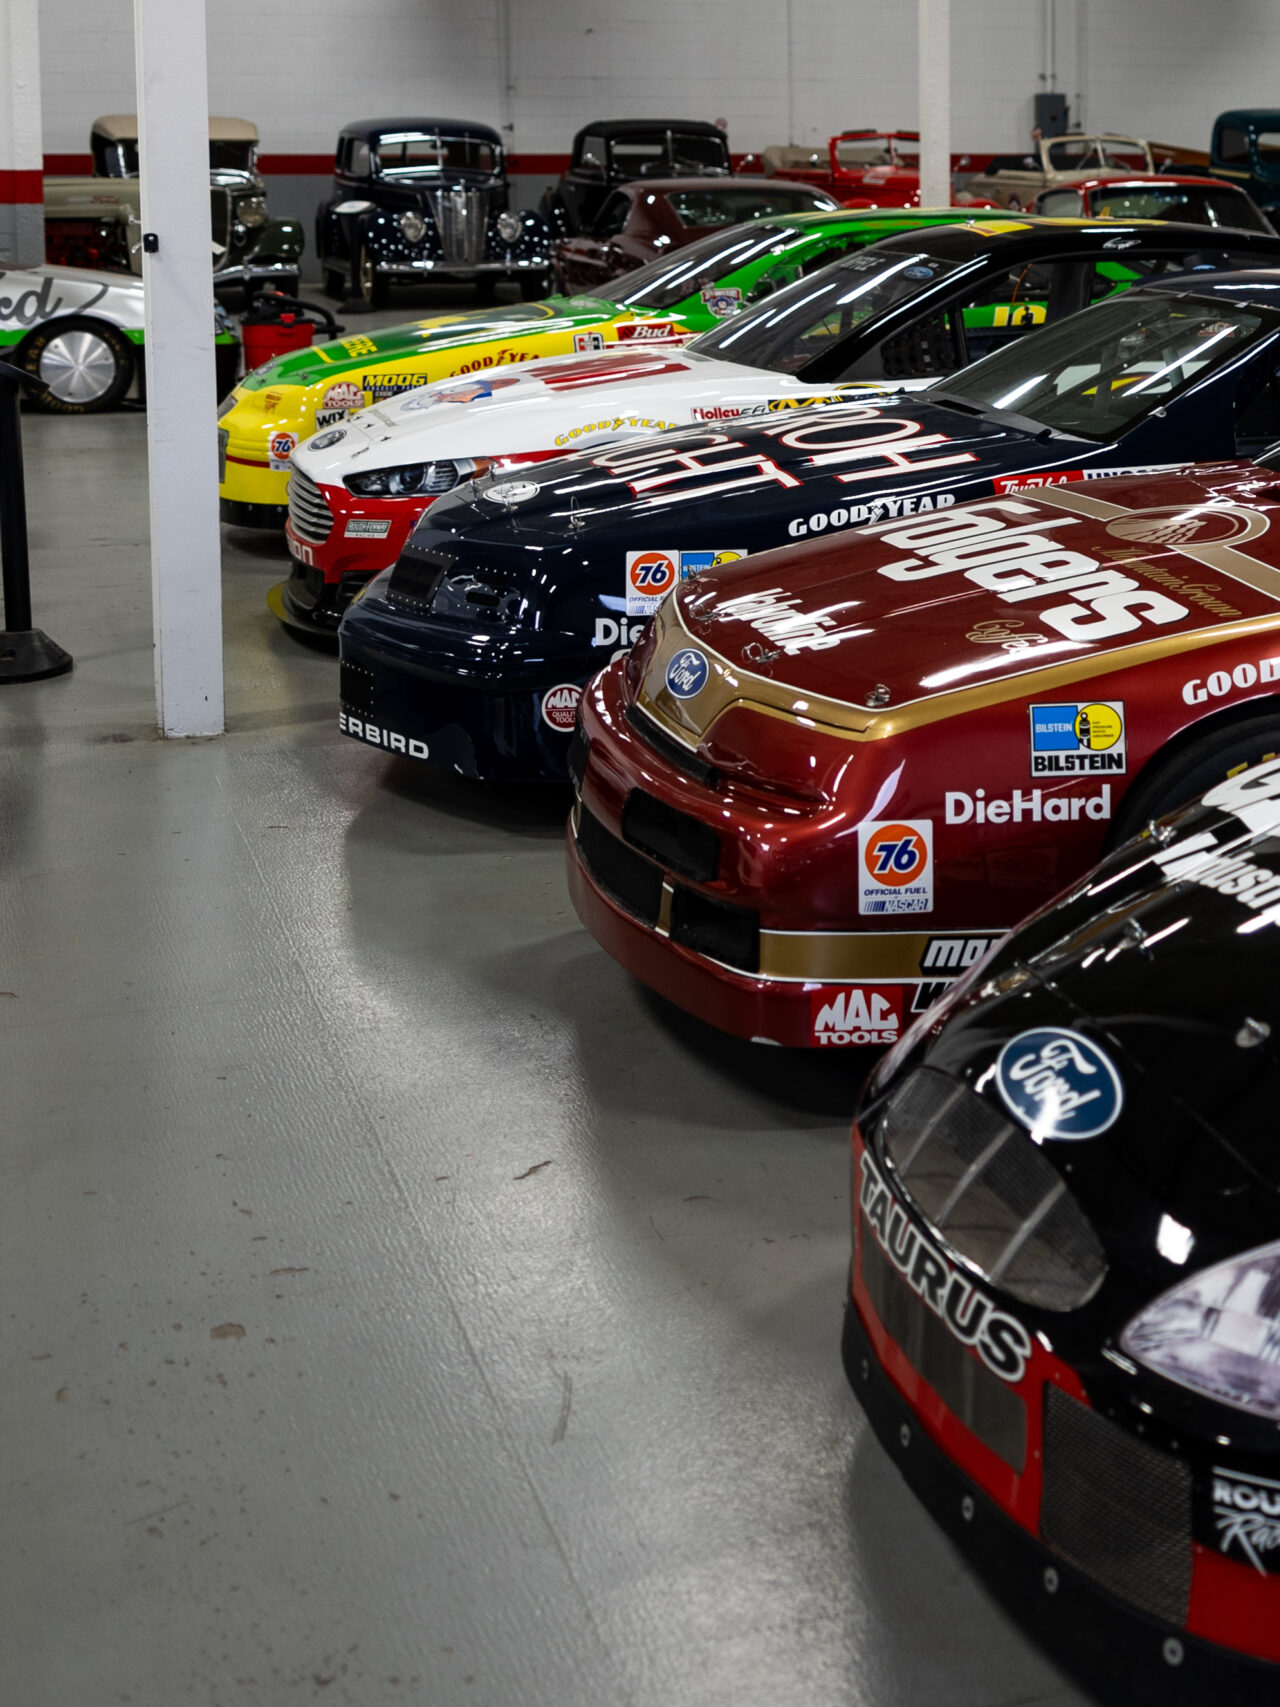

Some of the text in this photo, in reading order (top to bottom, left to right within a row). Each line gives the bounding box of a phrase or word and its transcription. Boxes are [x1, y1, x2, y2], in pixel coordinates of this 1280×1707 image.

[633, 325, 671, 338] Bud
[364, 374, 425, 386] MOOG
[327, 383, 363, 400] MAC
[326, 400, 364, 408] TOOLS
[316, 410, 346, 429] WIX
[275, 439, 292, 453] 76
[787, 493, 956, 536] GOODYEAR
[635, 560, 670, 587] 76
[669, 652, 702, 691] Ford
[1035, 722, 1073, 733] BILSTEIN
[1033, 752, 1123, 773] BILSTEIN
[944, 783, 1111, 825] DieHard
[872, 835, 919, 874] 76
[864, 887, 927, 896] OFFICIAL FUEL
[815, 989, 899, 1032] MAC
[815, 1031, 899, 1045] TOOLS
[1009, 1039, 1103, 1120] Ford
[859, 1150, 1032, 1383] TAURUS
